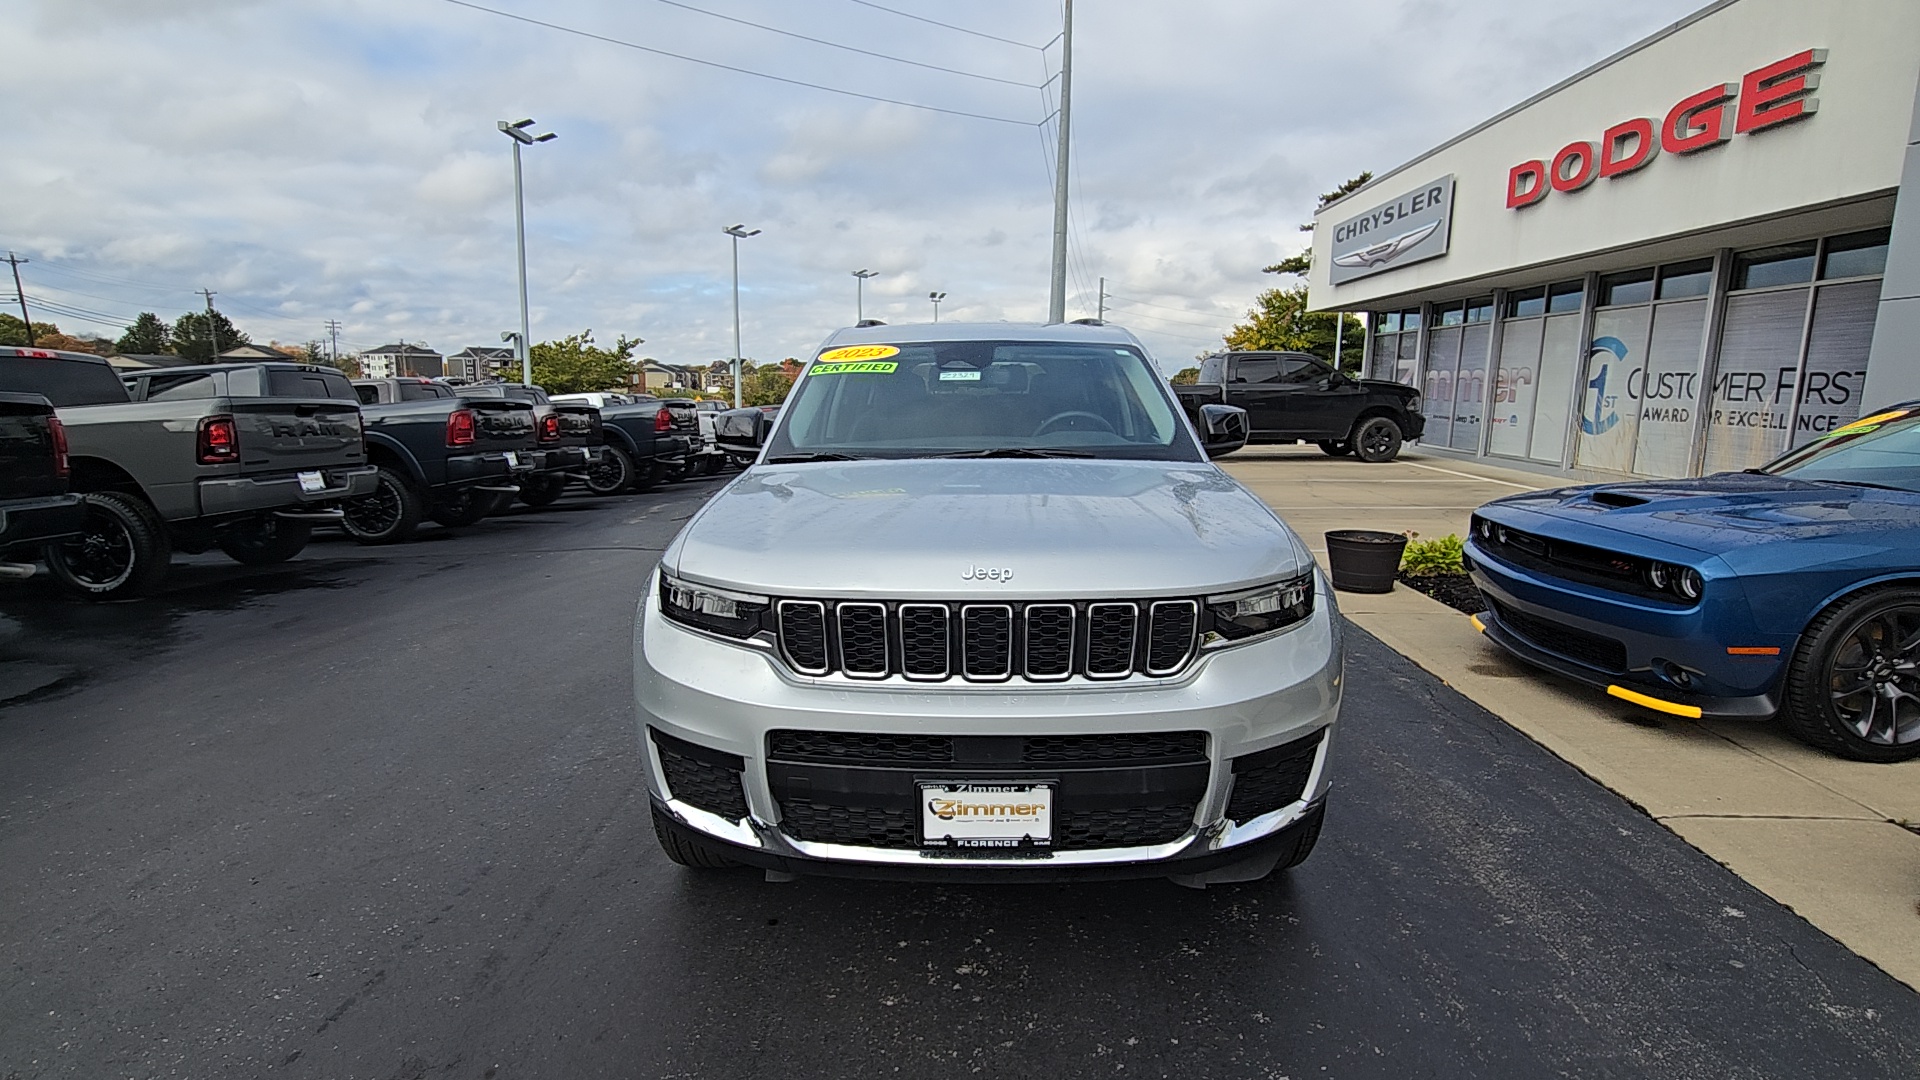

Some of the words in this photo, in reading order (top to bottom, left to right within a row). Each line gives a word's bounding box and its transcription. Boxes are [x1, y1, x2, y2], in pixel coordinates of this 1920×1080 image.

[1506, 47, 1828, 209] DODGE
[1336, 186, 1442, 243] CHRYSLER
[830, 347, 888, 360] 2023
[812, 363, 893, 374] CERTIFIED
[1642, 407, 1690, 423] AWARD
[1727, 411, 1839, 432] EXCELLNCE
[271, 423, 341, 438] RAM
[961, 564, 1014, 583] Jeep
[956, 784, 1019, 793] Zimmer
[935, 799, 1046, 818] Zimmer
[957, 840, 1019, 848] FLORENCE
